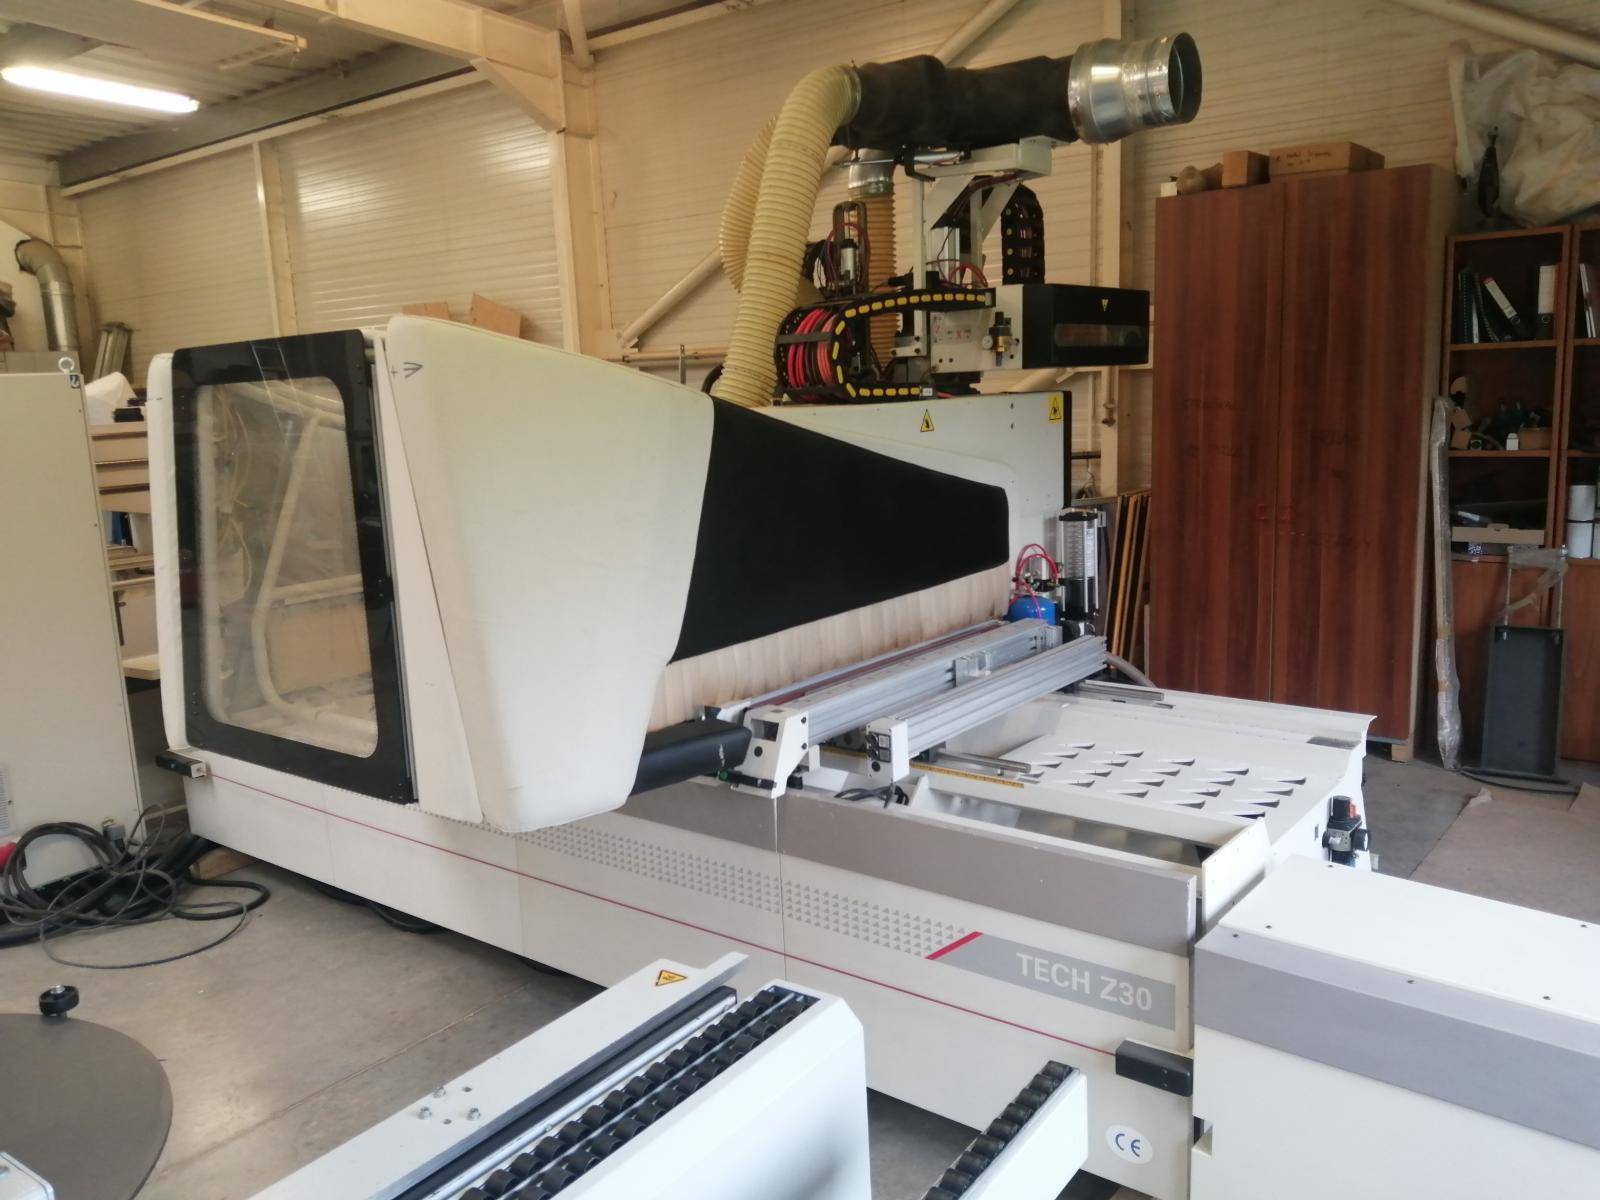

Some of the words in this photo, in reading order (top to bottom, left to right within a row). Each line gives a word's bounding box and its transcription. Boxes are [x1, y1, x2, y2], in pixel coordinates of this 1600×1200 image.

[1016, 952, 1091, 994] TECH
[1100, 975, 1152, 1011] Z30
[1115, 1133, 1141, 1158] CE
